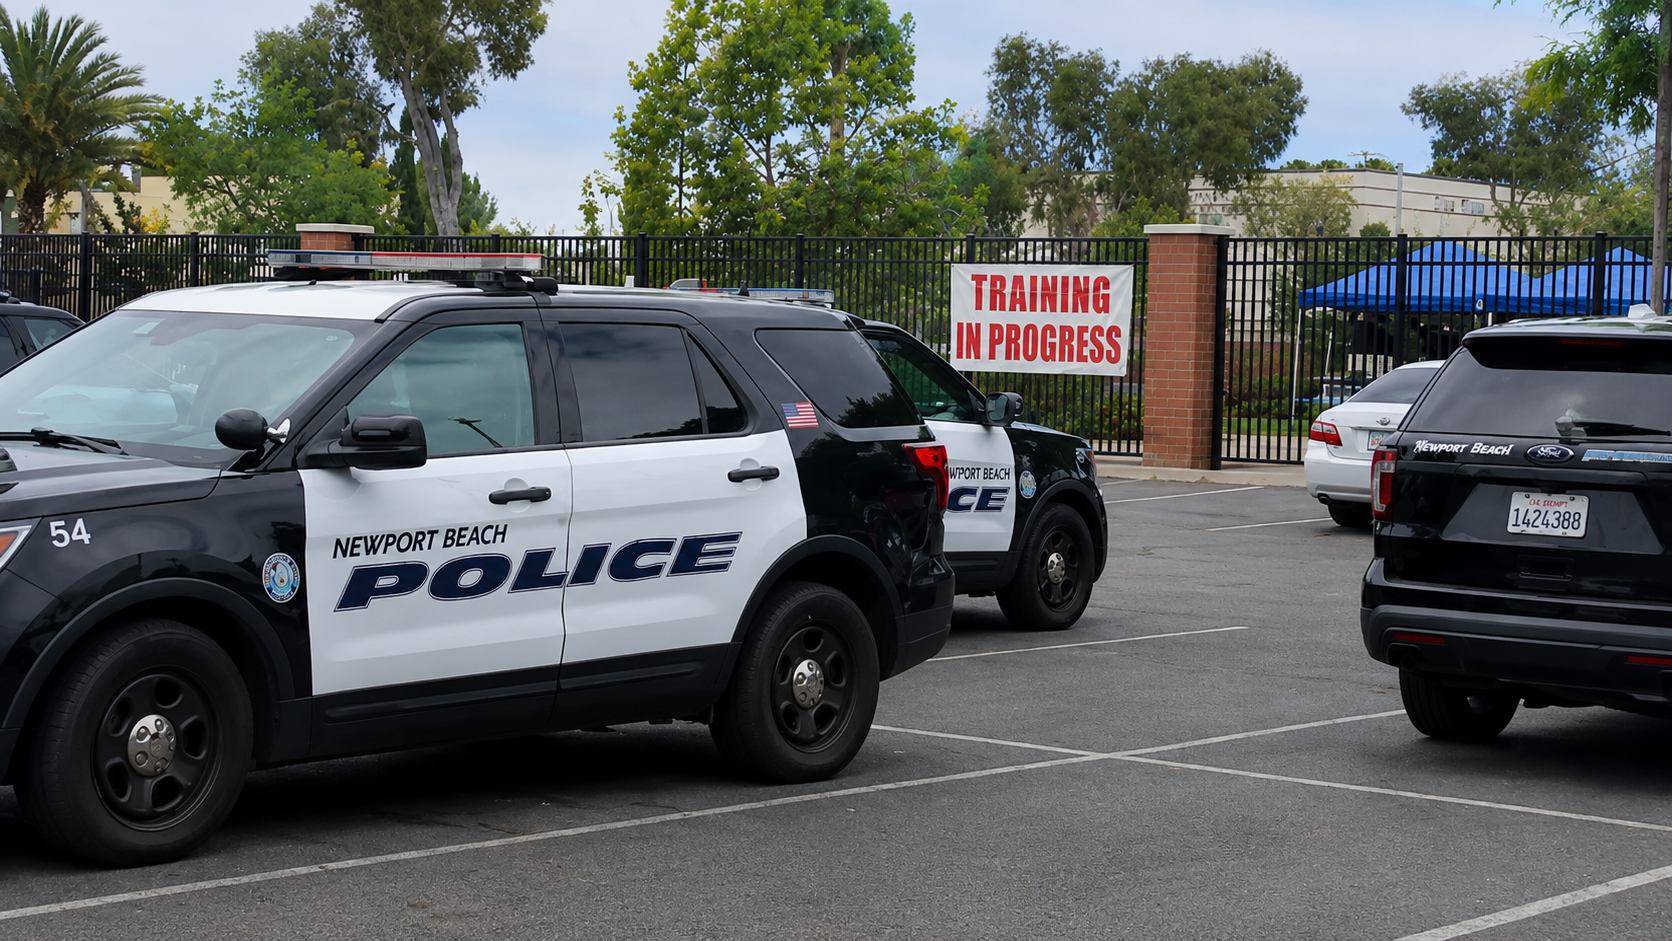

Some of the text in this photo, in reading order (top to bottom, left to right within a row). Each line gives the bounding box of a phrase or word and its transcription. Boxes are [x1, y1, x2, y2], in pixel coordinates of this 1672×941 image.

[971, 274, 1110, 314] TRAINING
[956, 322, 1122, 364] IN PROGRESS
[1413, 440, 1514, 455] NEWPORT BEACH
[949, 467, 1011, 480] WPORT BEACH
[49, 518, 91, 547] 54
[1512, 507, 1582, 530] 1424388
[333, 523, 508, 559] NEWPORT BEACH
[333, 531, 743, 612] POLICE
